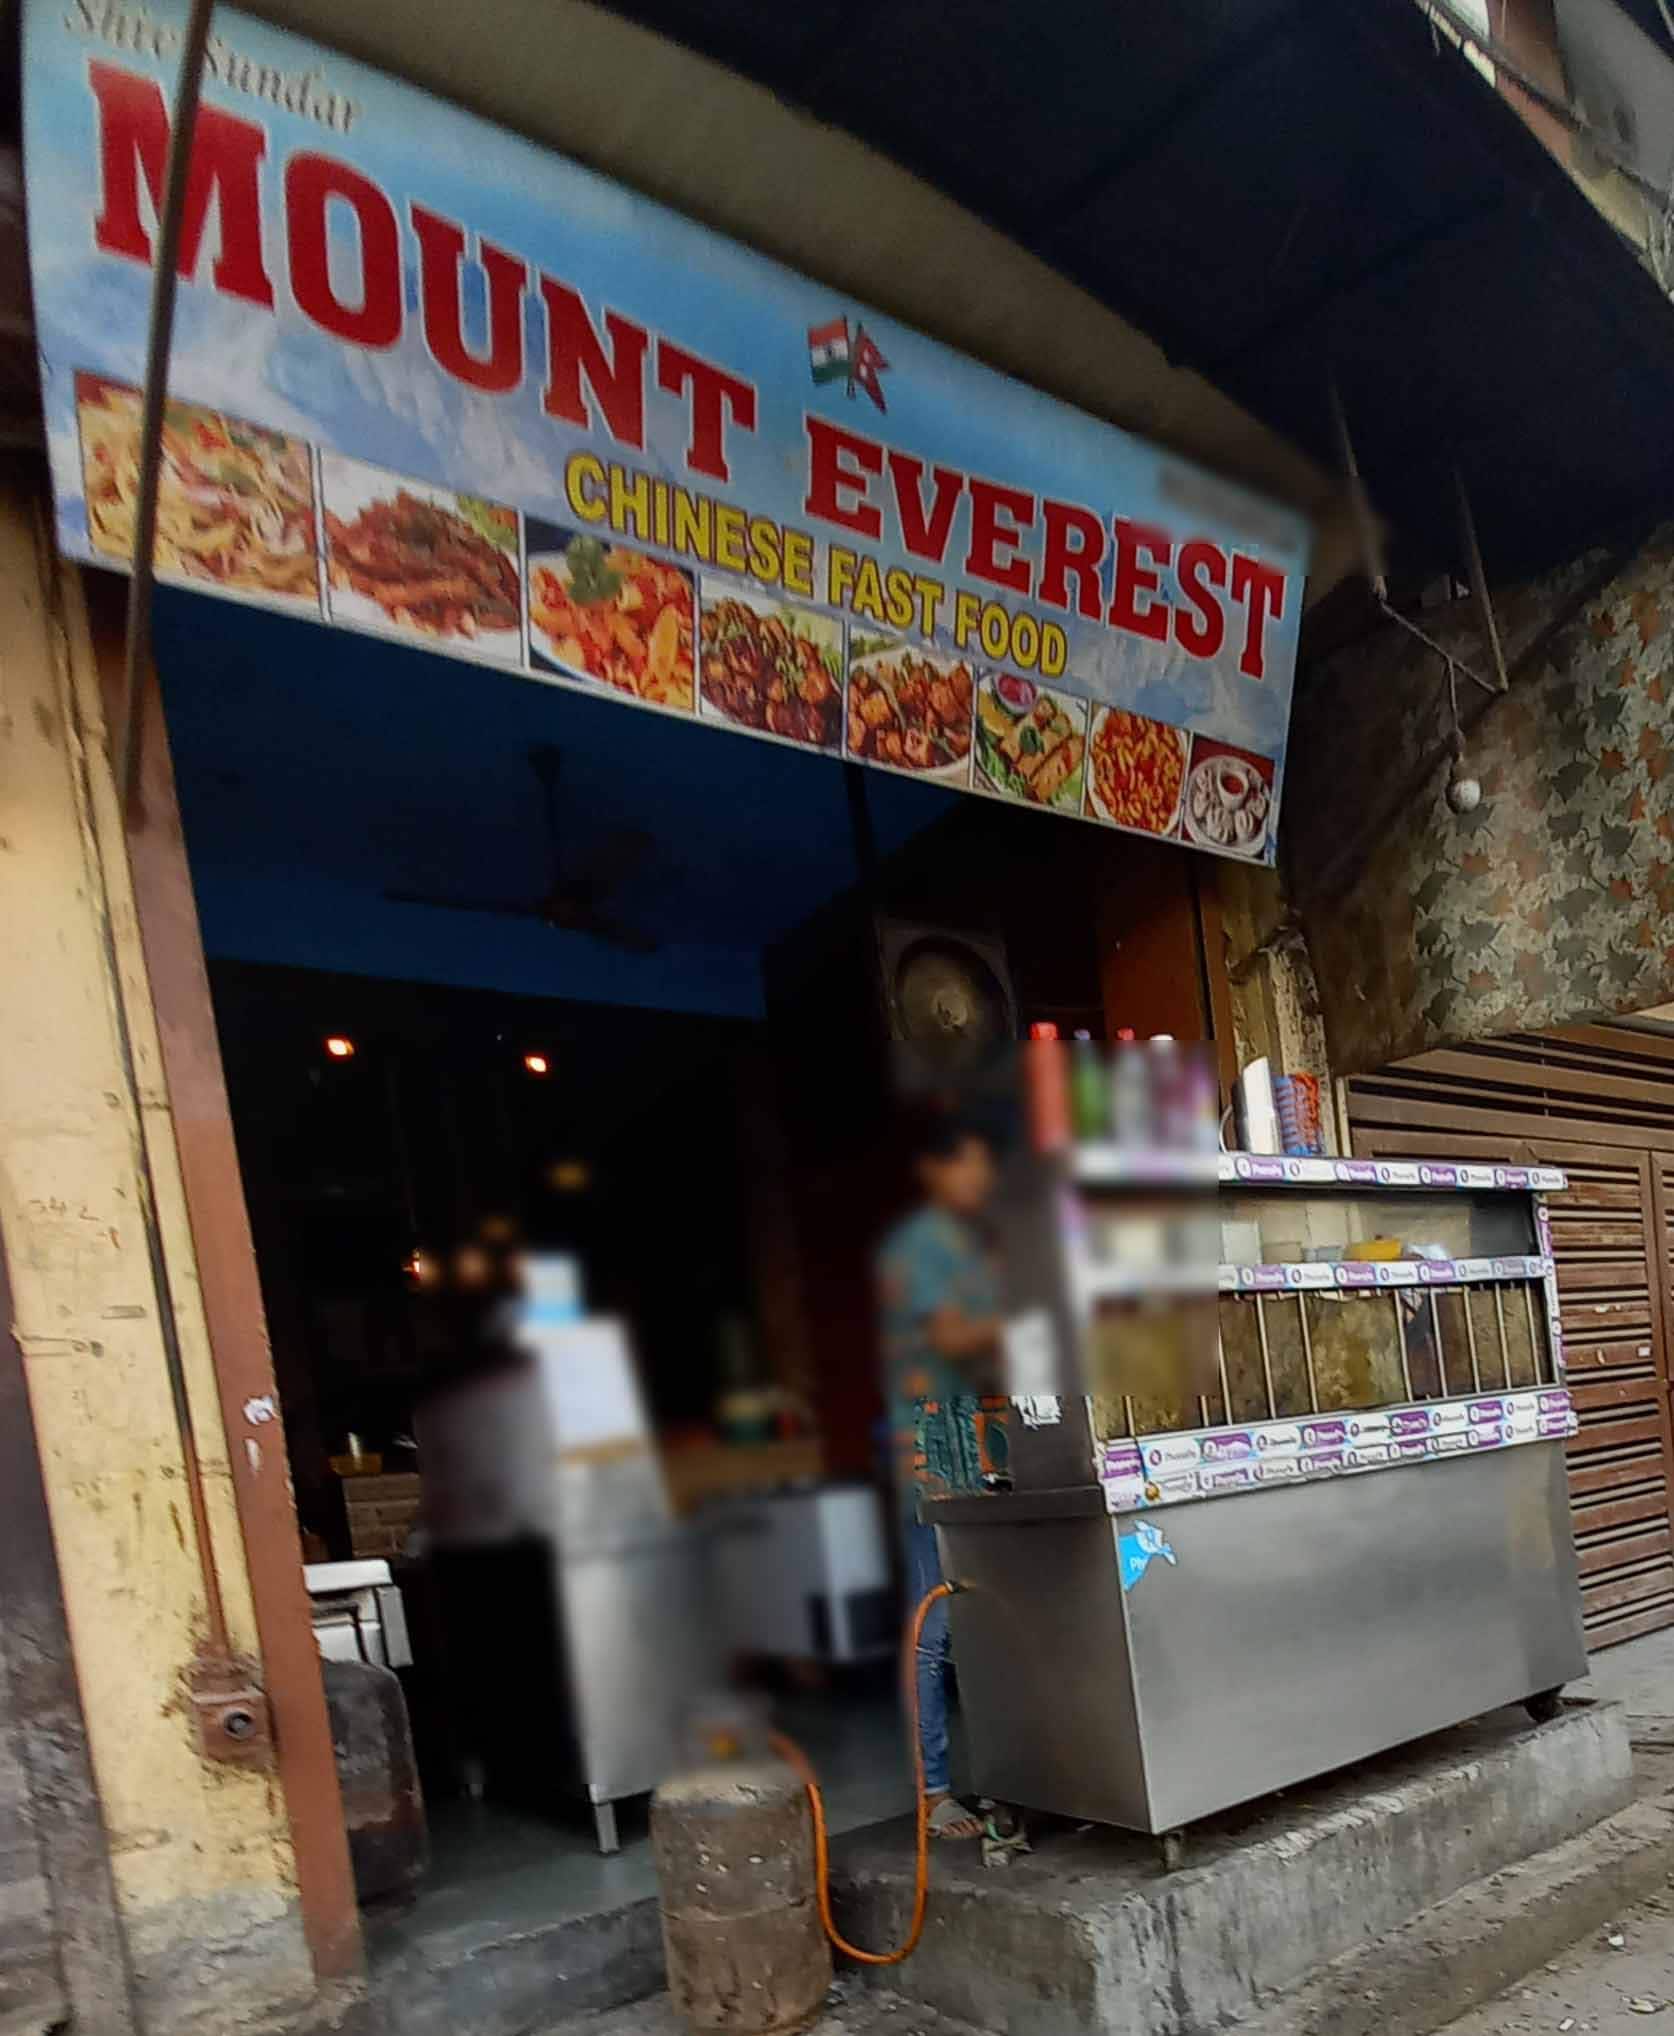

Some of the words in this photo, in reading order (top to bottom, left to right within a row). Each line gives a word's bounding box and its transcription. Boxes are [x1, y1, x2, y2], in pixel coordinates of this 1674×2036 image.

[87, 58, 758, 482] MOUNT
[804, 415, 1287, 680] EVEREST
[564, 452, 815, 597] CHINESE
[828, 544, 946, 640] FAST
[953, 590, 1068, 680] FOOD
